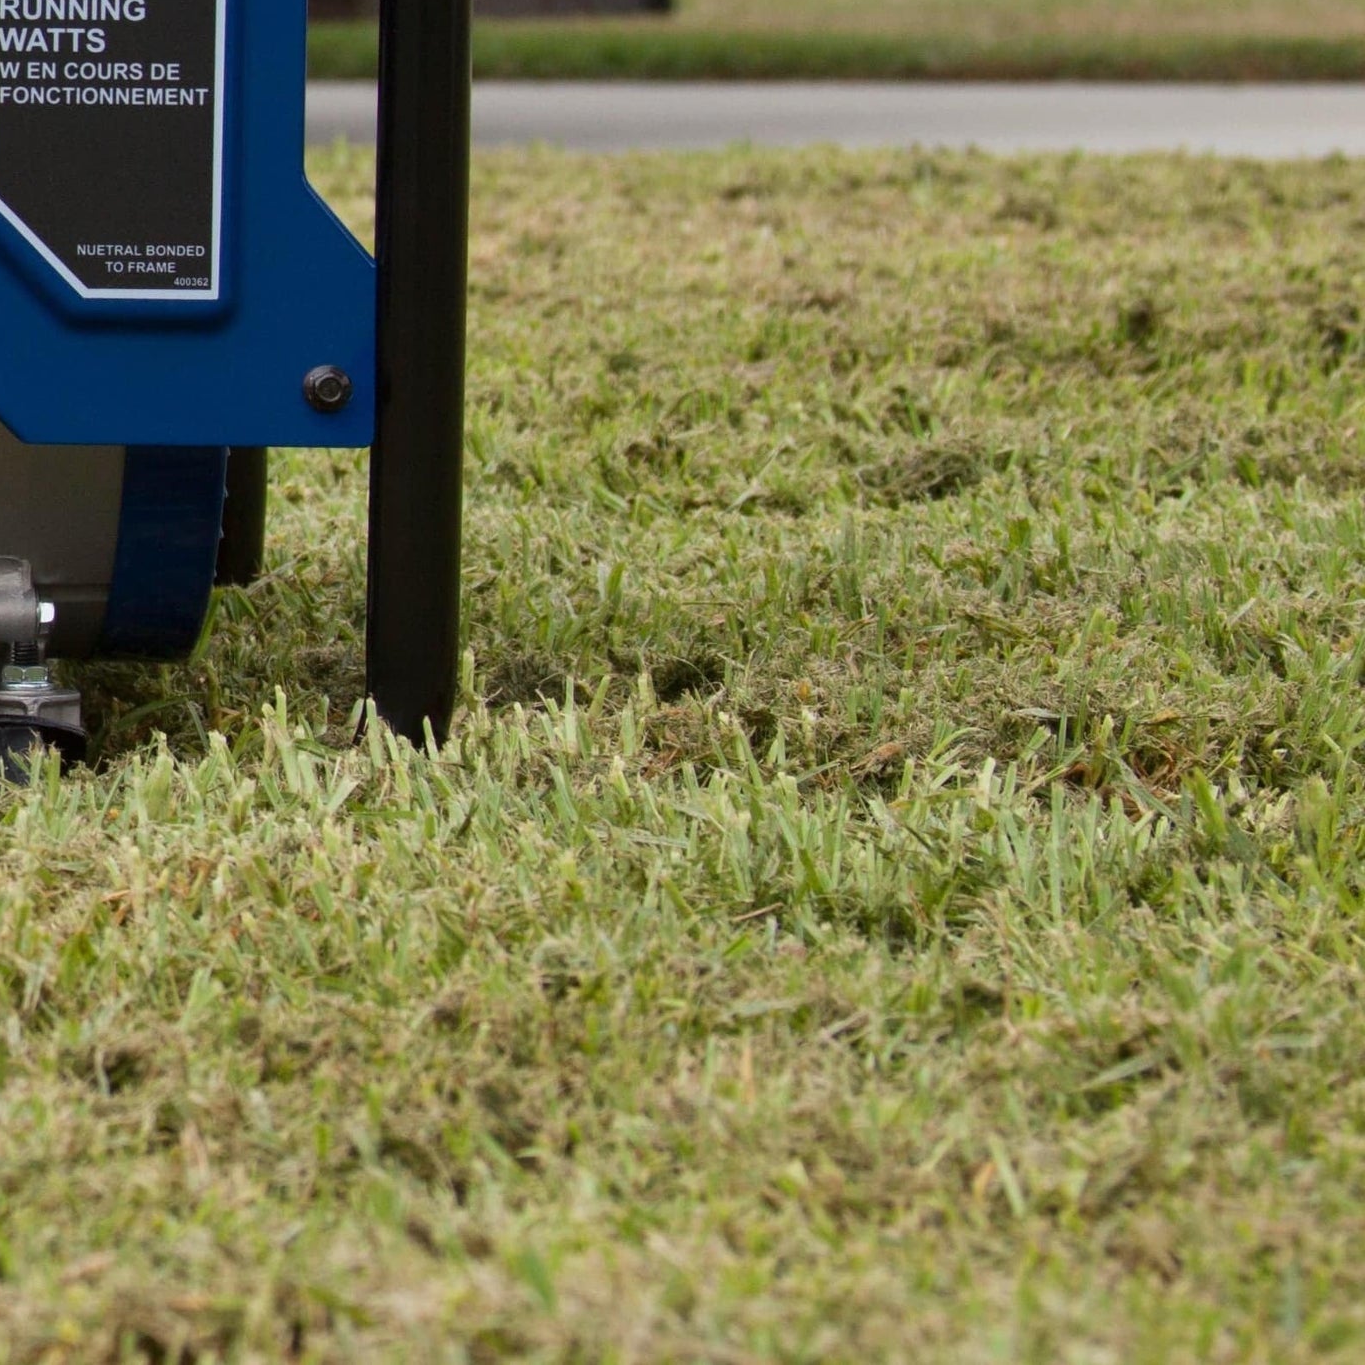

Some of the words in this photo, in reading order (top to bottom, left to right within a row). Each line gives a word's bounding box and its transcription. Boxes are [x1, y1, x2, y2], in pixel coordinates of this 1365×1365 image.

[0, 62, 20, 79] W
[27, 62, 56, 80] EN
[64, 62, 143, 81] COURS
[150, 63, 181, 81] DE
[0, 86, 209, 106] FONCTIONNEMENT
[77, 244, 142, 256] NUETRAL
[146, 245, 205, 257] BONDED
[105, 261, 124, 273] TO
[128, 262, 176, 273] FRAME
[173, 277, 209, 287] 400362
